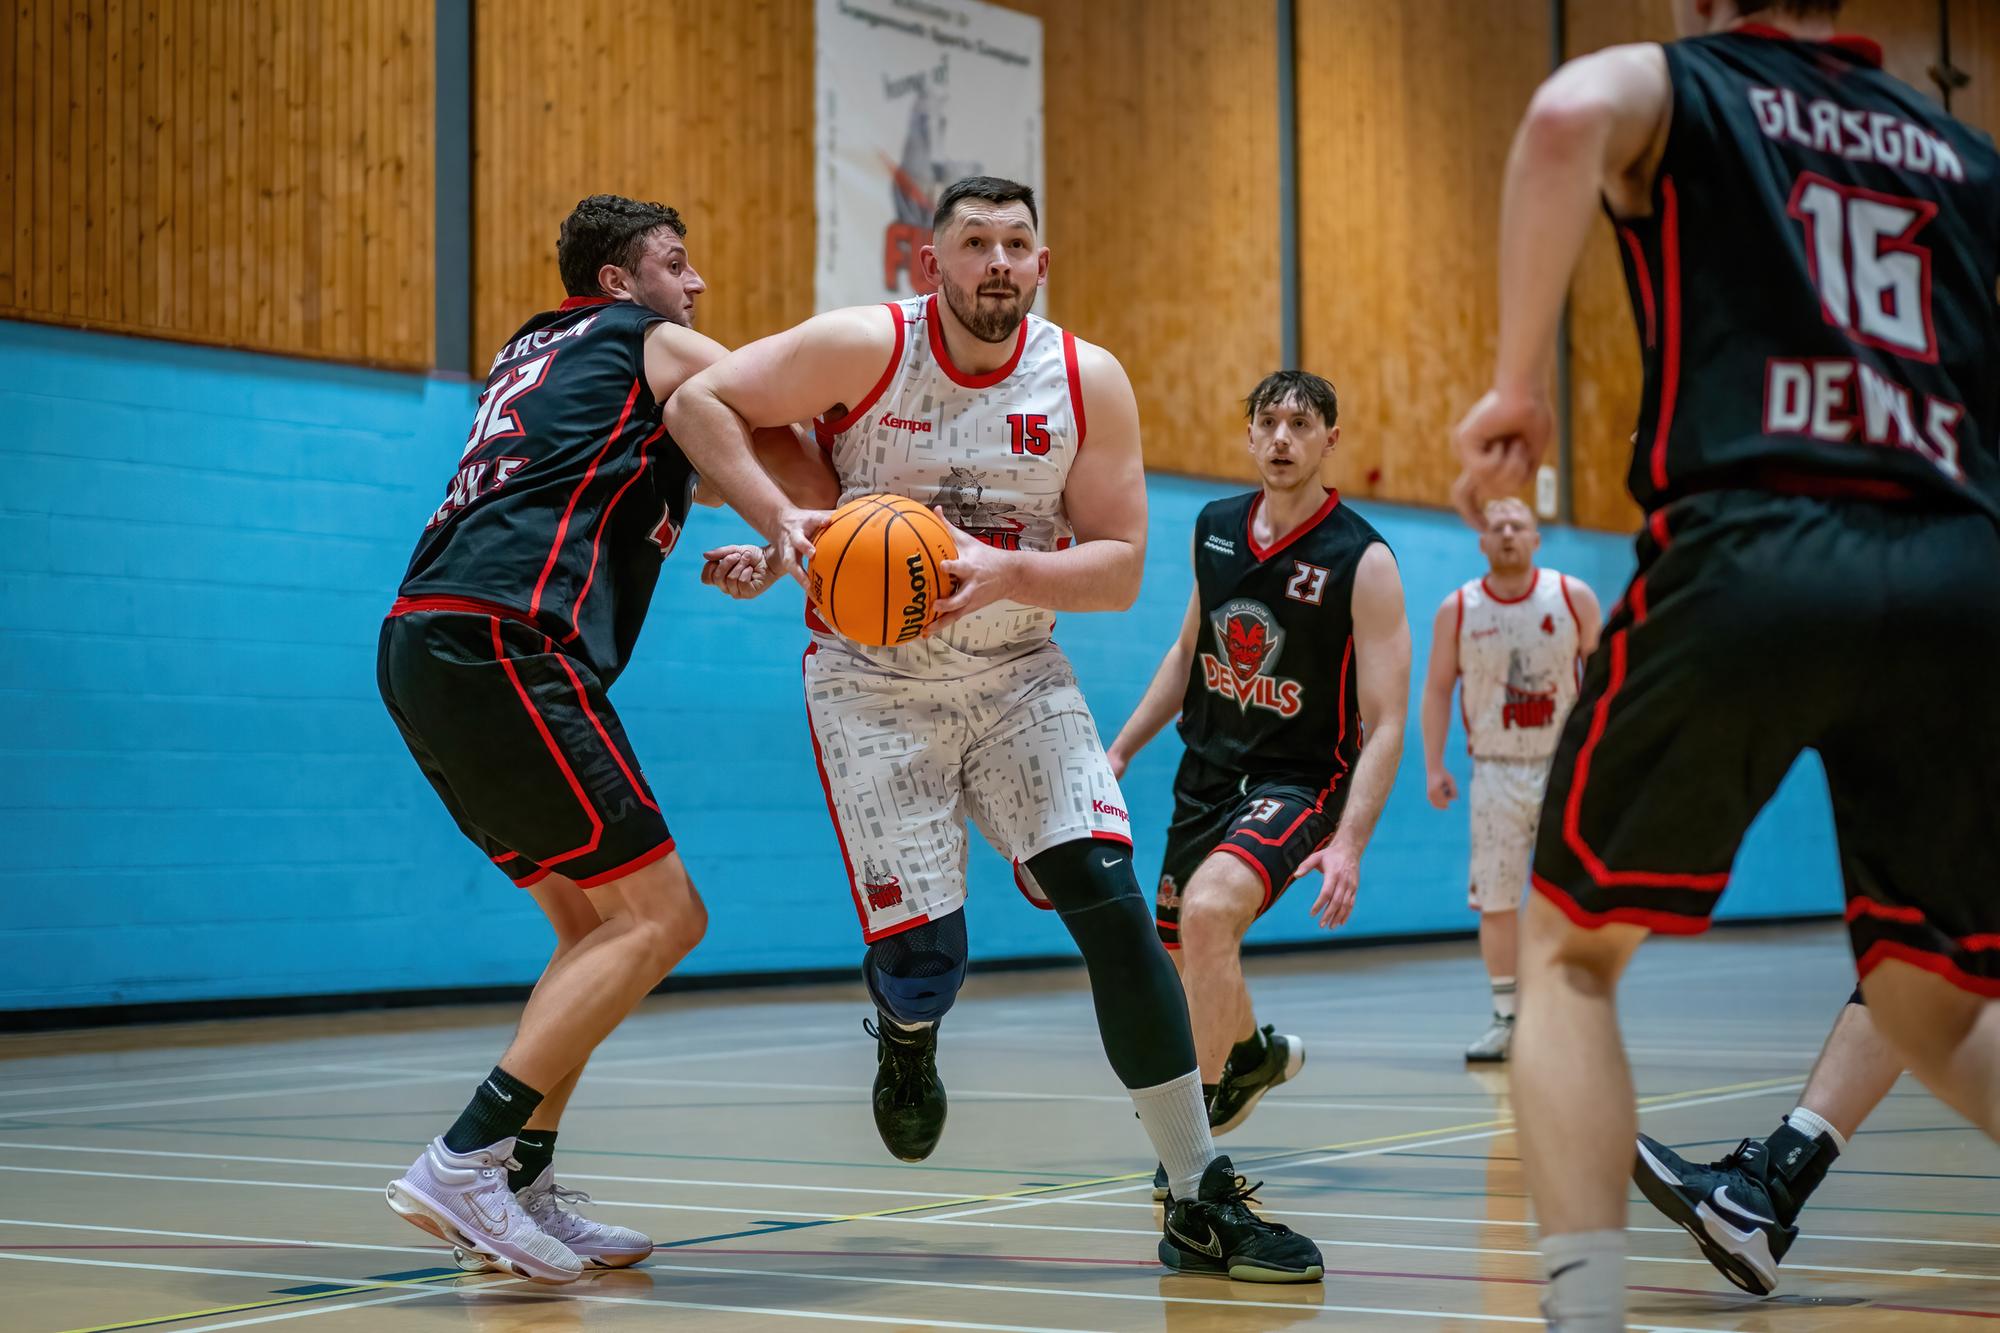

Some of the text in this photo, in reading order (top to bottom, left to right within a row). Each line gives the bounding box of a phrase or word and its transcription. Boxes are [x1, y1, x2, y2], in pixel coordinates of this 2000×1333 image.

[1789, 172, 1939, 363] 16
[879, 412, 932, 434] Kempa
[1007, 413, 1051, 456] 15
[895, 552, 928, 643] Wilson
[1285, 559, 1332, 607] 23
[1231, 603, 1269, 618] GLASGOW
[1540, 613, 1554, 636] 4
[1200, 653, 1303, 719] DEVILS
